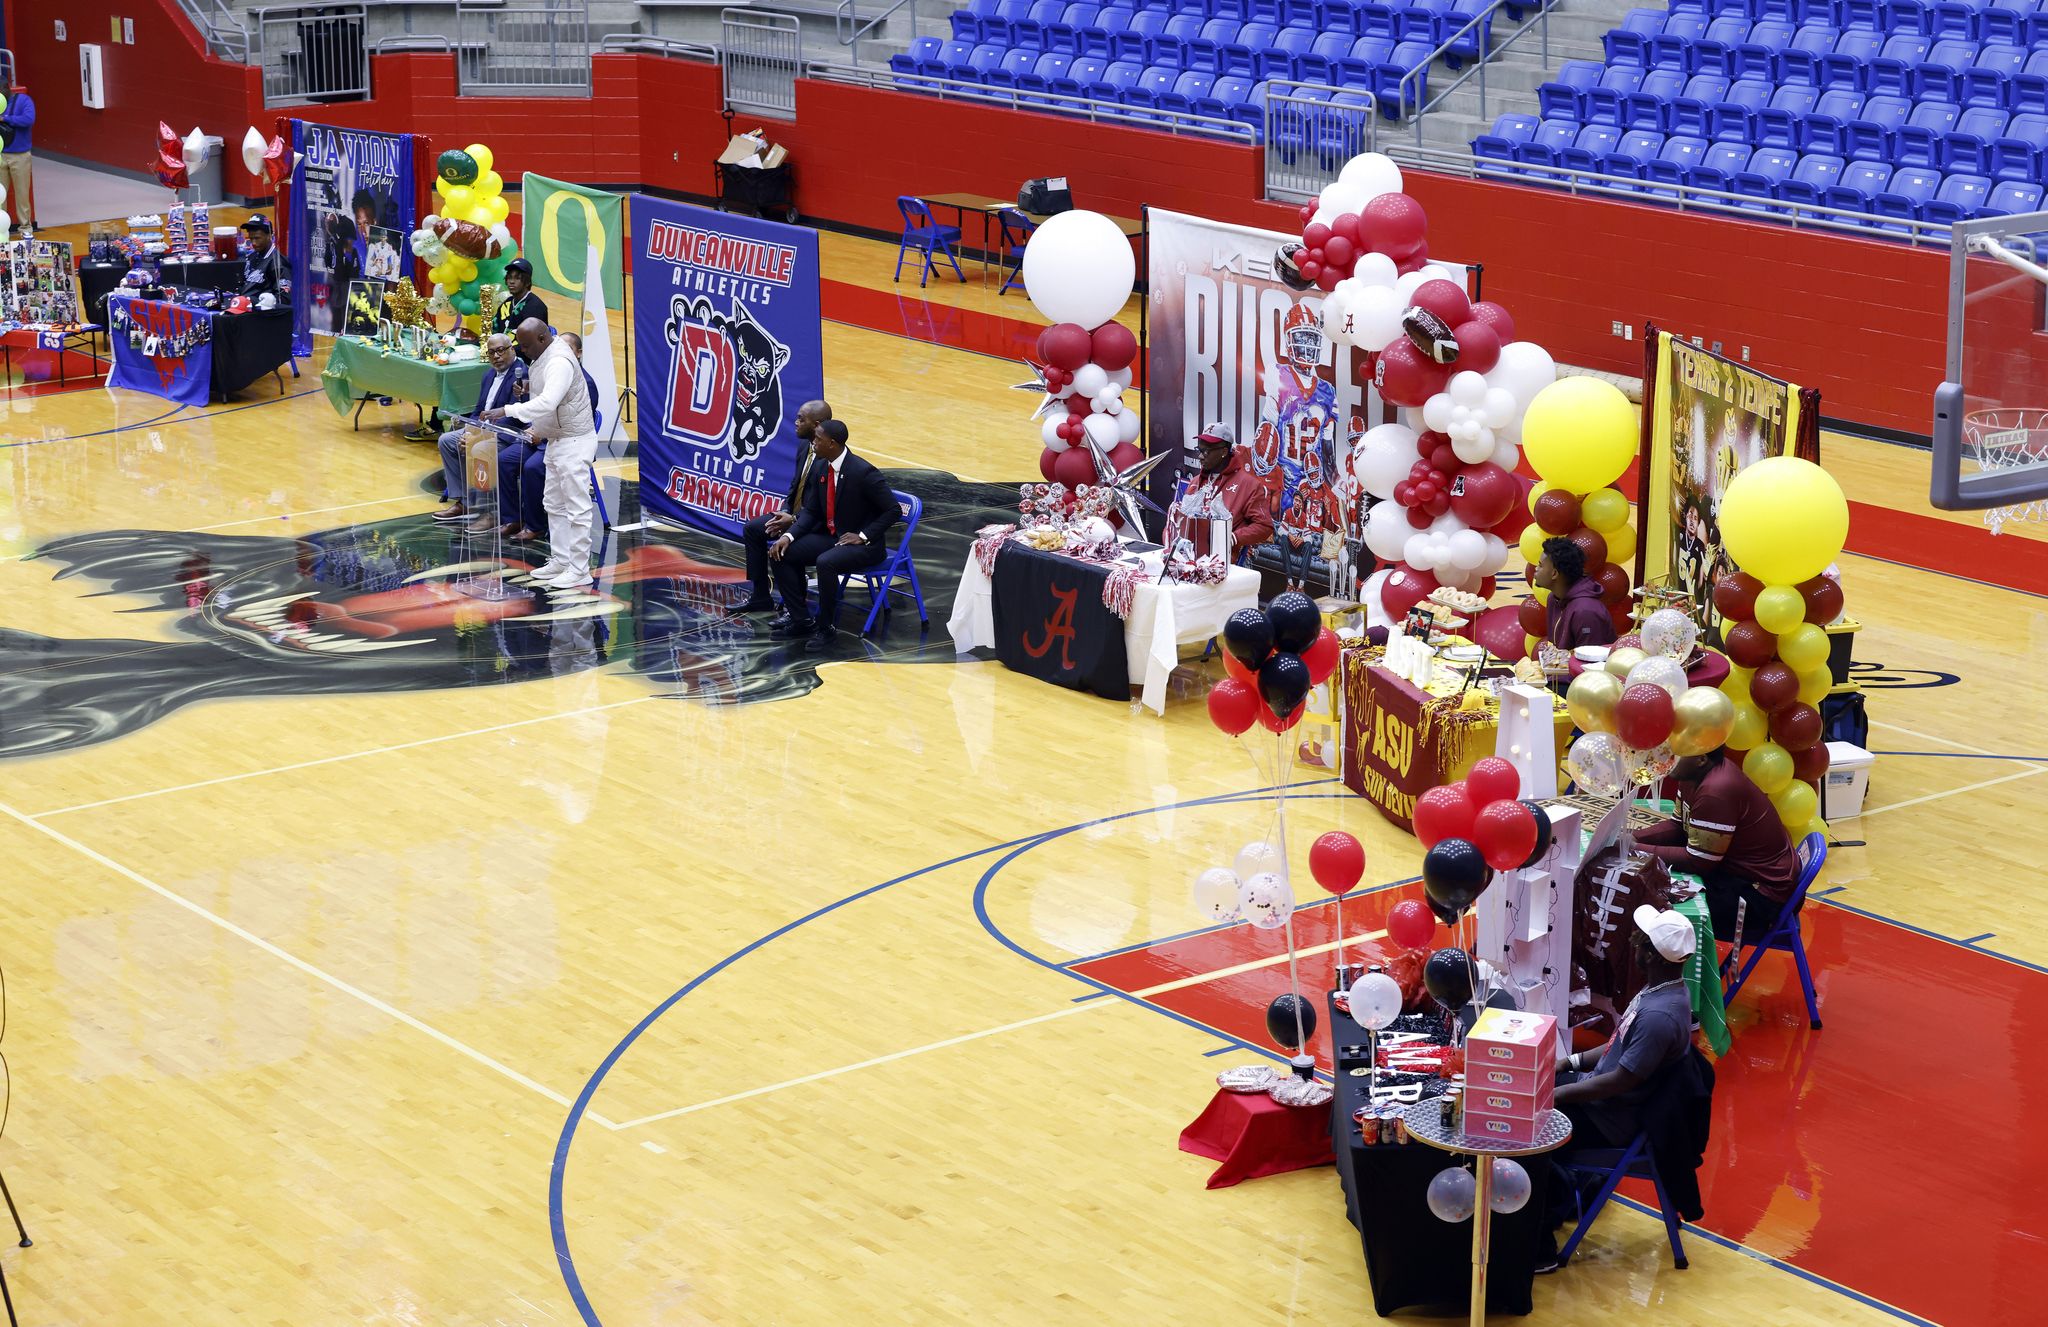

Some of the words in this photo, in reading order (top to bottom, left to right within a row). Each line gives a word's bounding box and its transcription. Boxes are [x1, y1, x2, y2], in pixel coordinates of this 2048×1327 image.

[306, 128, 400, 177] JAVION
[358, 163, 394, 195] Holiday
[648, 221, 796, 286] DUNCANVILLE
[672, 266, 772, 305] ATHLETICS
[129, 298, 193, 341] SMU
[1341, 313, 1354, 334] A
[1722, 362, 1735, 404] 2
[693, 451, 733, 478] CITY
[743, 464, 765, 486] OF
[666, 468, 787, 523] CHAMPION
[1226, 484, 1238, 493] A
[1023, 582, 1079, 670] A
[1372, 704, 1414, 778] ASU
[1363, 764, 1387, 805] SUN
[1491, 1048, 1511, 1057] YUM
[1490, 1073, 1510, 1082] YUM
[1489, 1097, 1509, 1107] YUM
[1488, 1122, 1508, 1131] YUM
